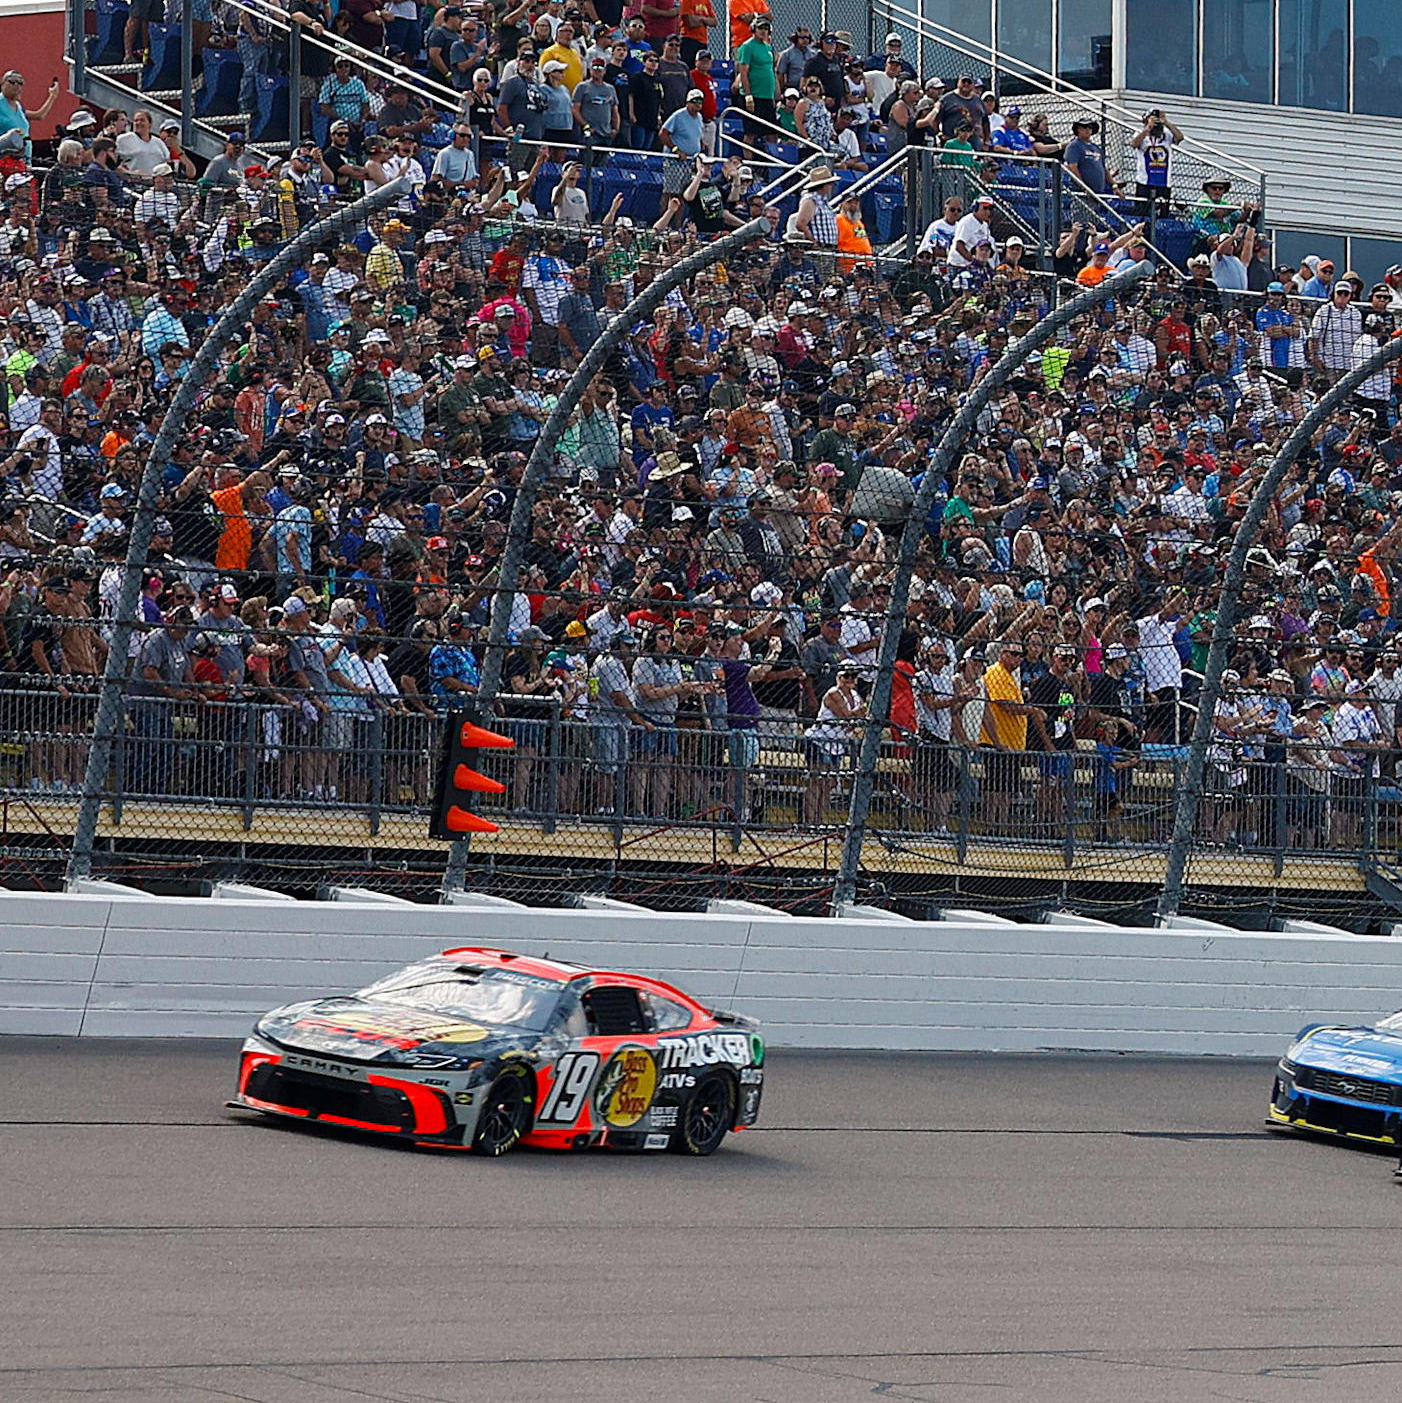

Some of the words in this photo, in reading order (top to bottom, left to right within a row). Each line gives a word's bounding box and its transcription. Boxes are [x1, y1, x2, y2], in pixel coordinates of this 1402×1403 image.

[657, 1034, 751, 1068] TRACKER
[287, 1055, 359, 1076] CAMRY
[538, 1051, 600, 1123] 19
[659, 1073, 696, 1089] ATVs
